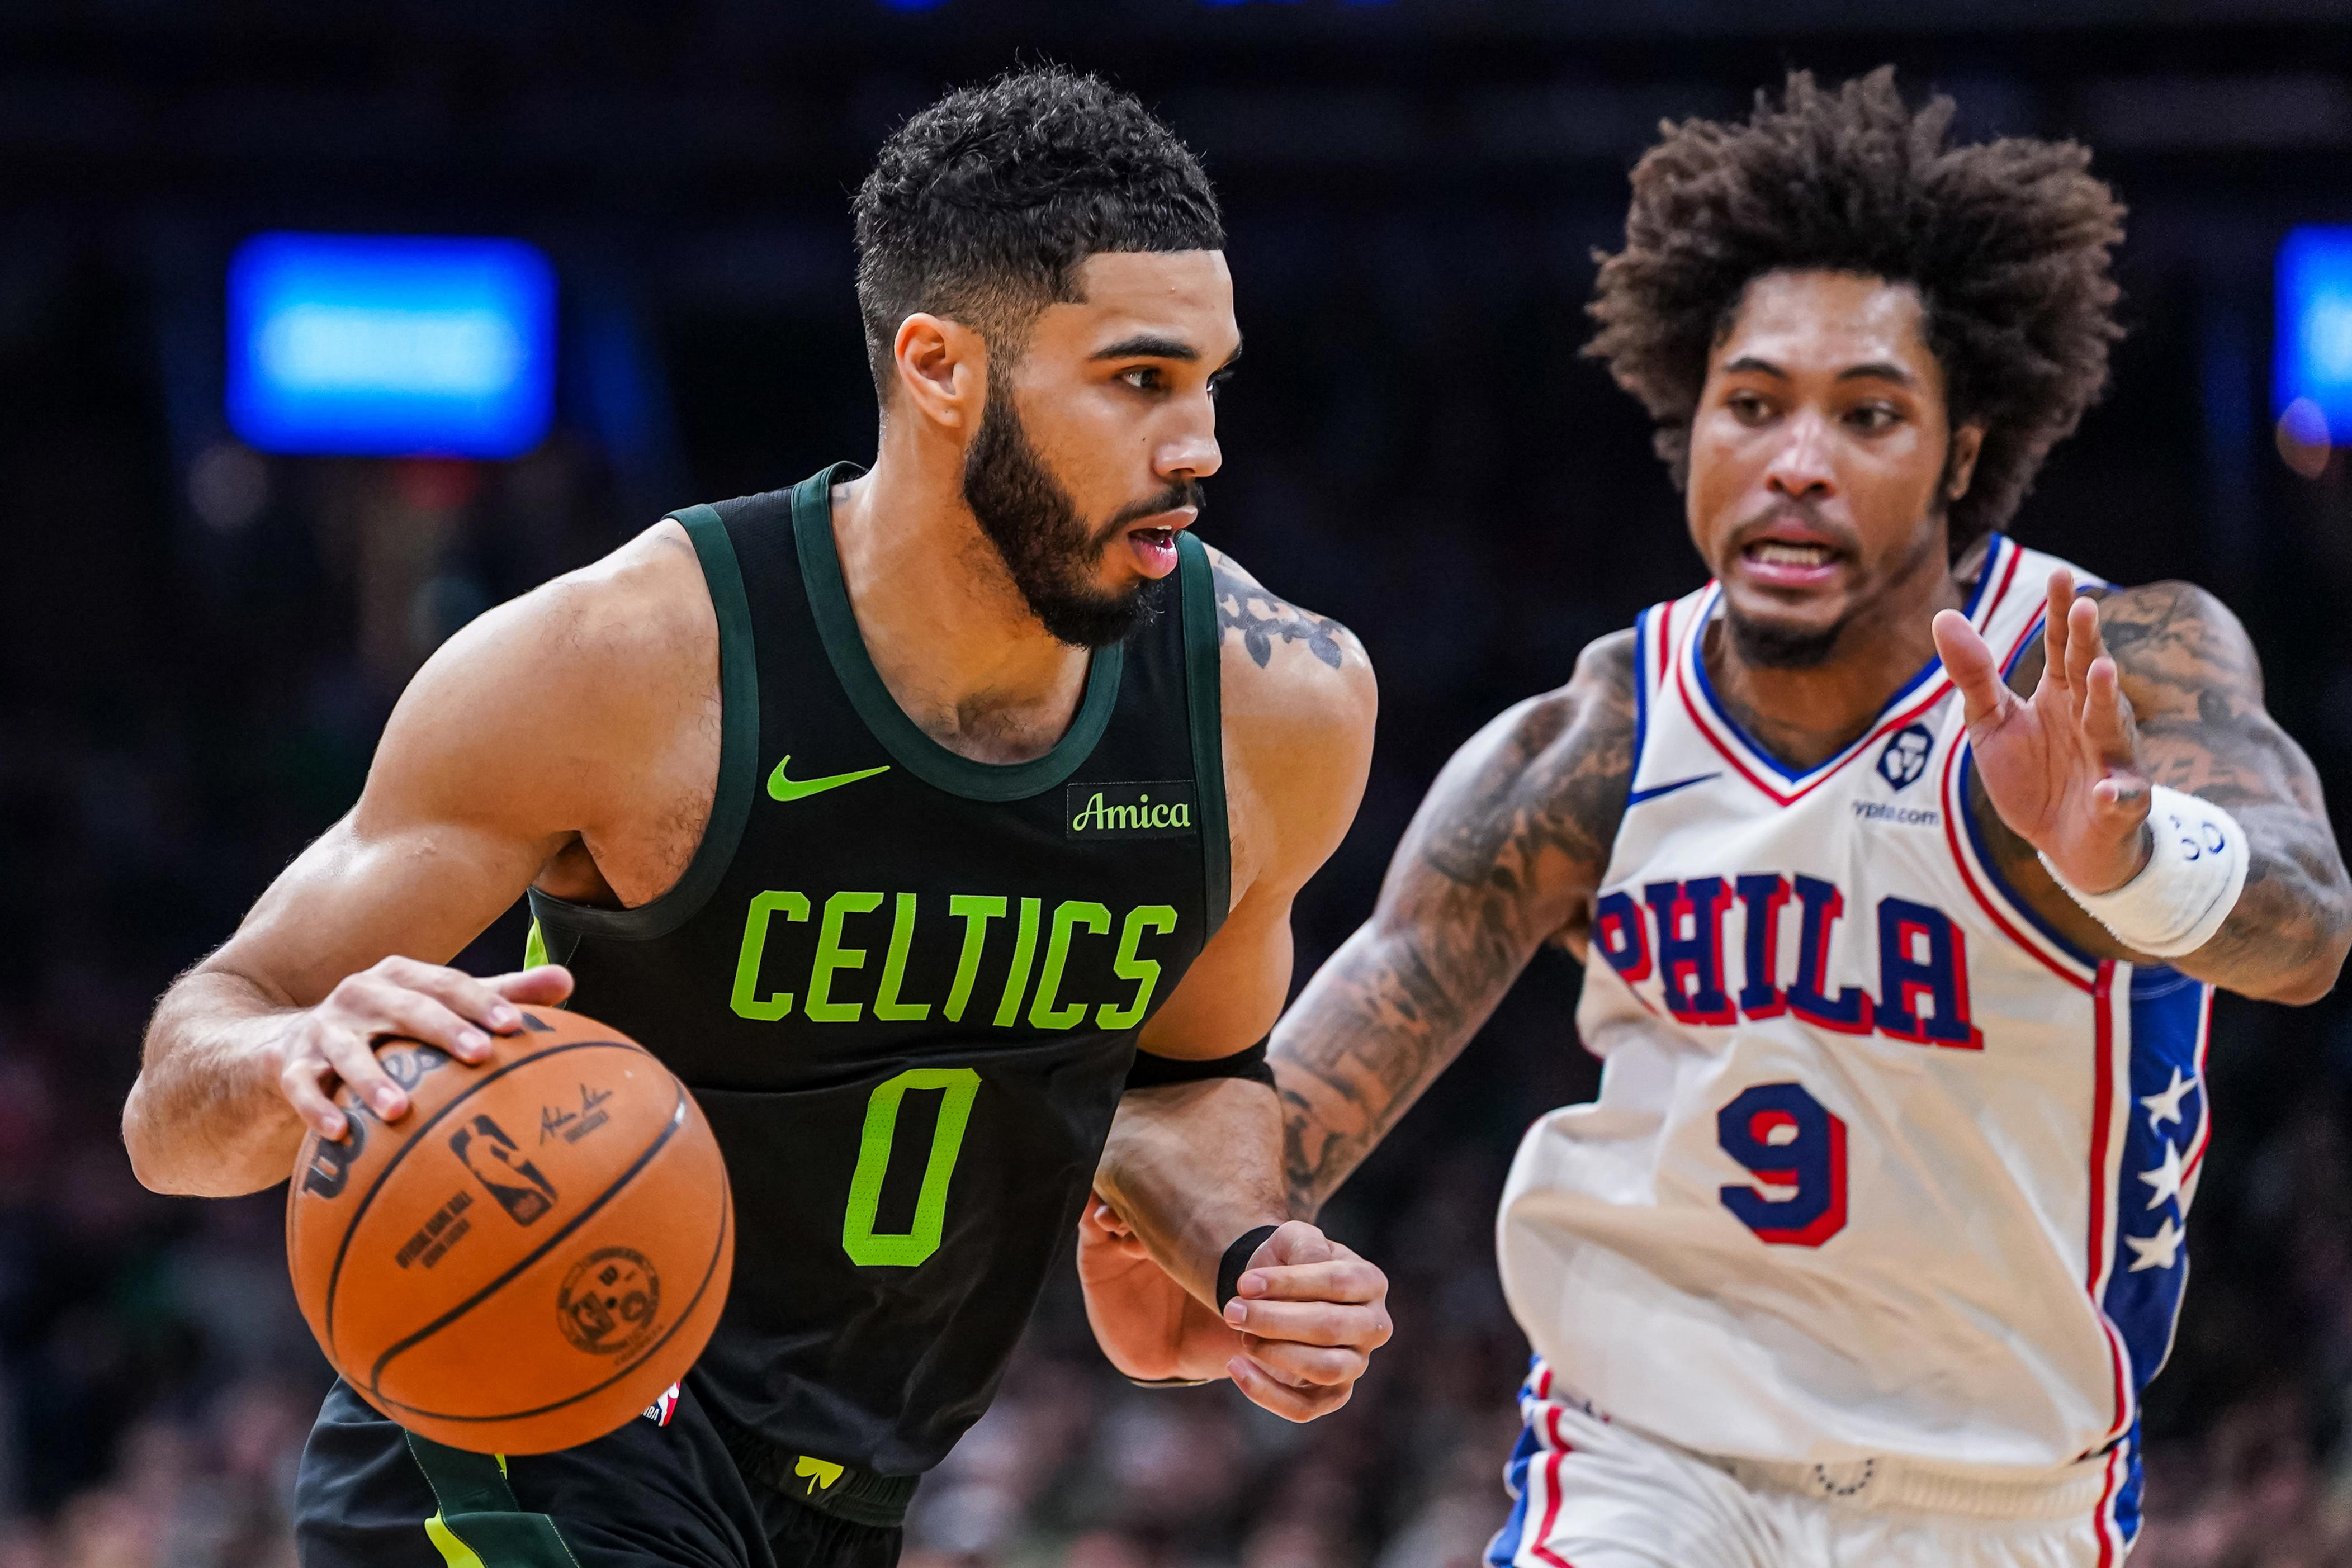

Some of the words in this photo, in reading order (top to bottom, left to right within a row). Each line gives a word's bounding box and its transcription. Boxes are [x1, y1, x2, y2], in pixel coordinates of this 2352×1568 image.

[1072, 792, 1191, 831] Amica
[730, 890, 1178, 1030] CELTICS
[1592, 872, 1984, 1050] PHILA
[842, 1067, 982, 1267] 0
[1717, 1081, 1848, 1249] 9
